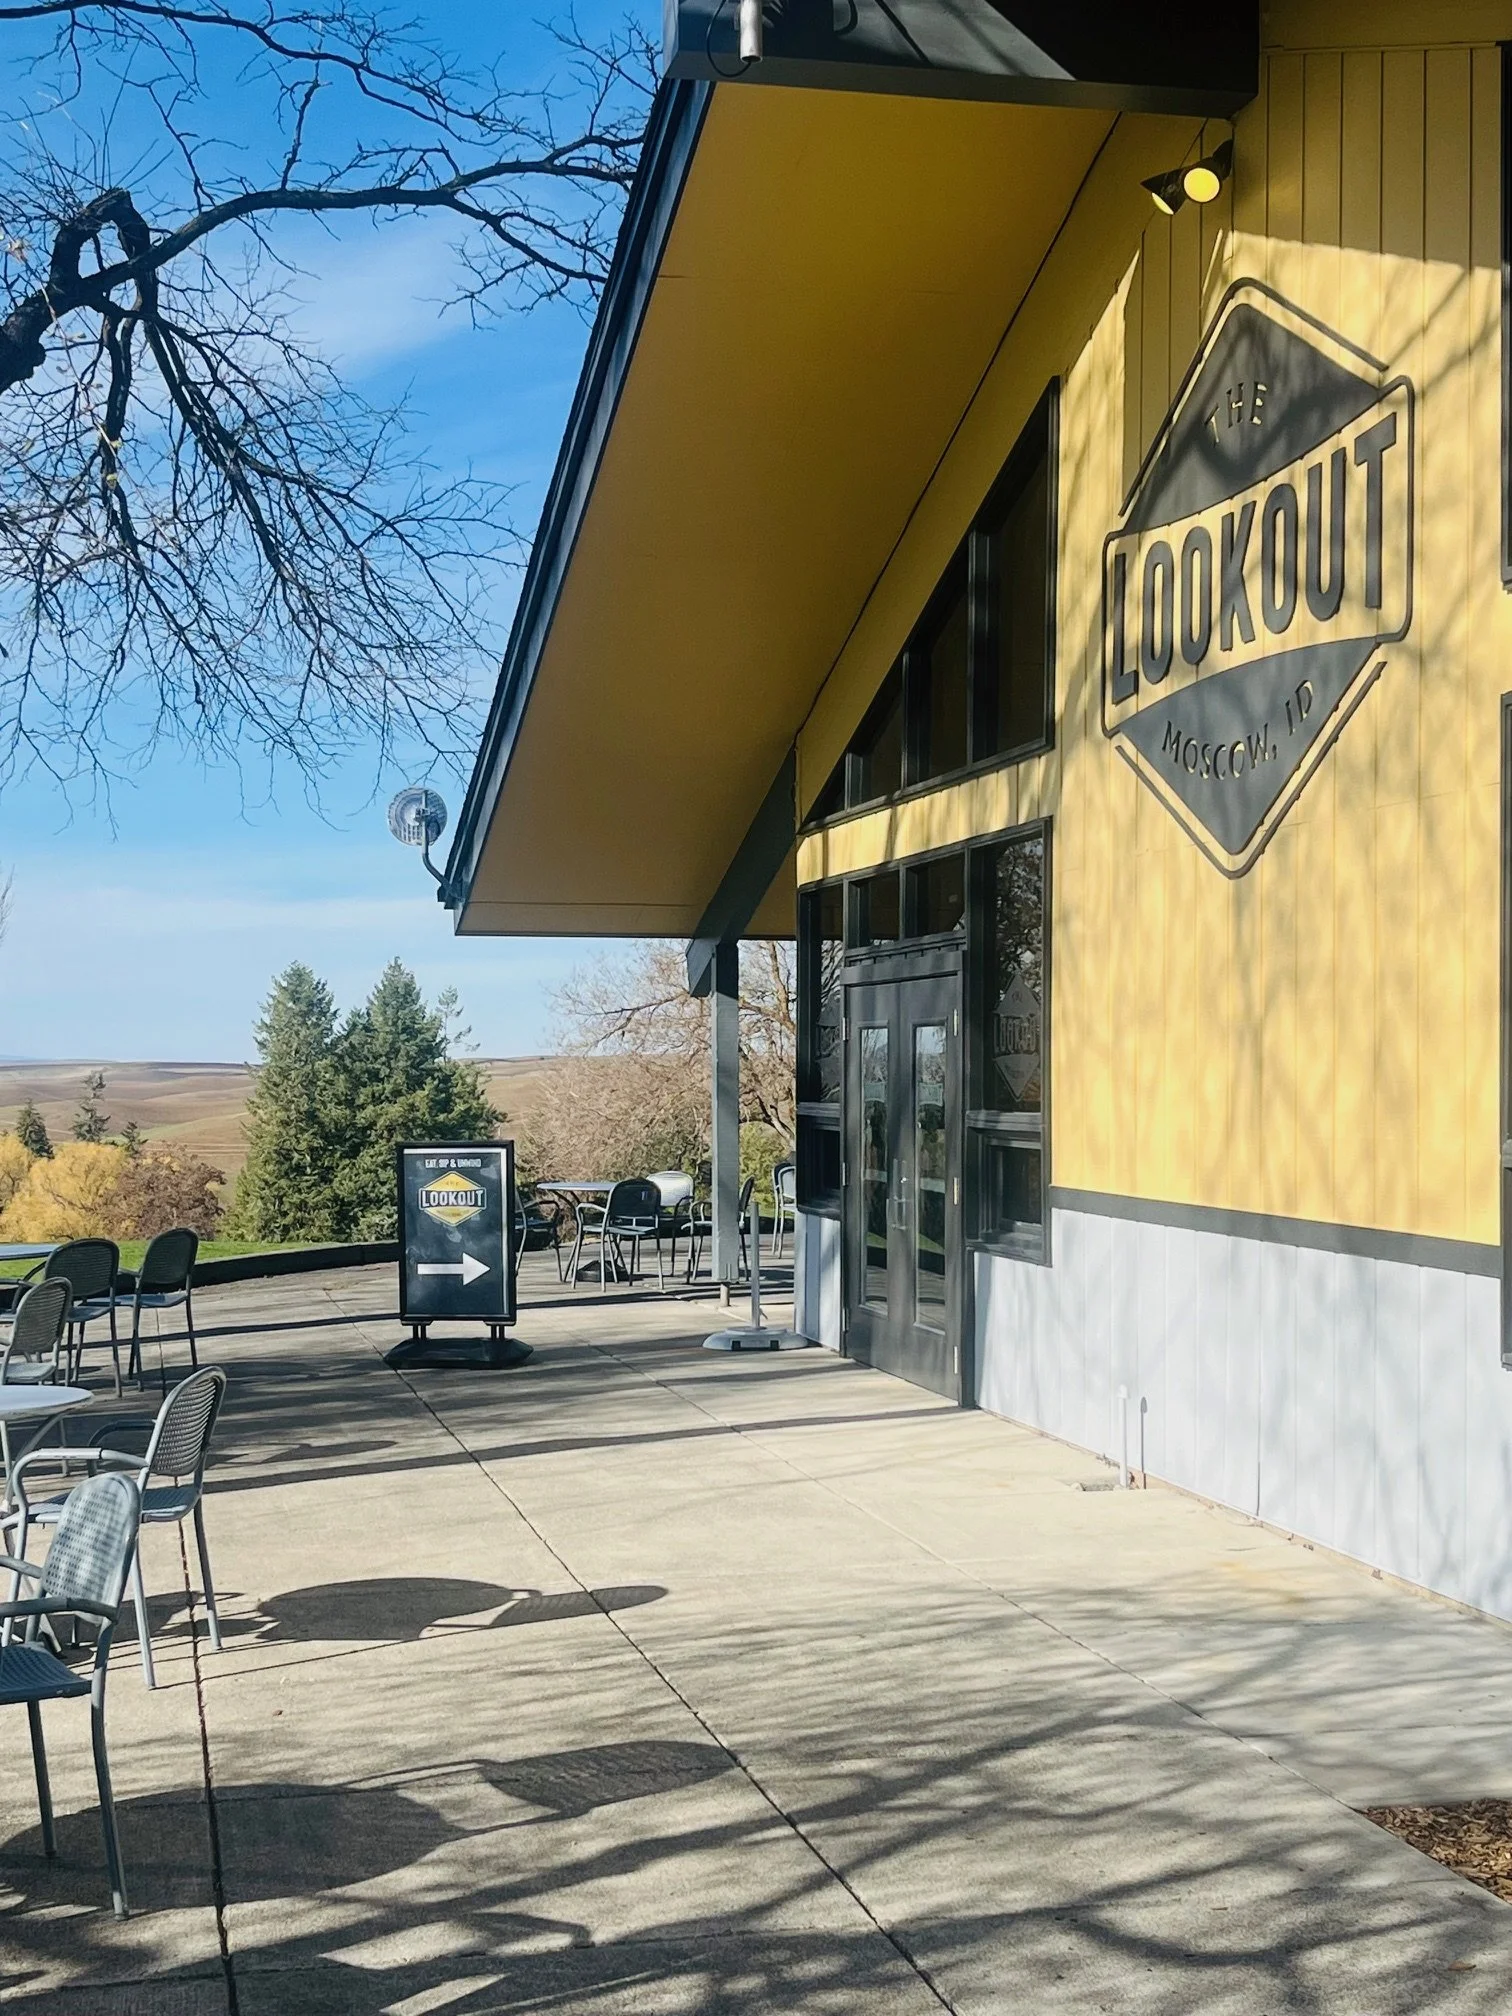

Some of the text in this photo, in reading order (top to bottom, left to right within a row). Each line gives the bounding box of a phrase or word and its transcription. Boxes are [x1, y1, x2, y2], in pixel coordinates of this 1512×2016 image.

[1204, 381, 1267, 445] THE
[1112, 412, 1398, 706] LOOKOUT
[1162, 679, 1314, 780] MOSCOW, ID
[450, 1158, 456, 1168] &
[422, 1190, 484, 1208] LOOKOUT
